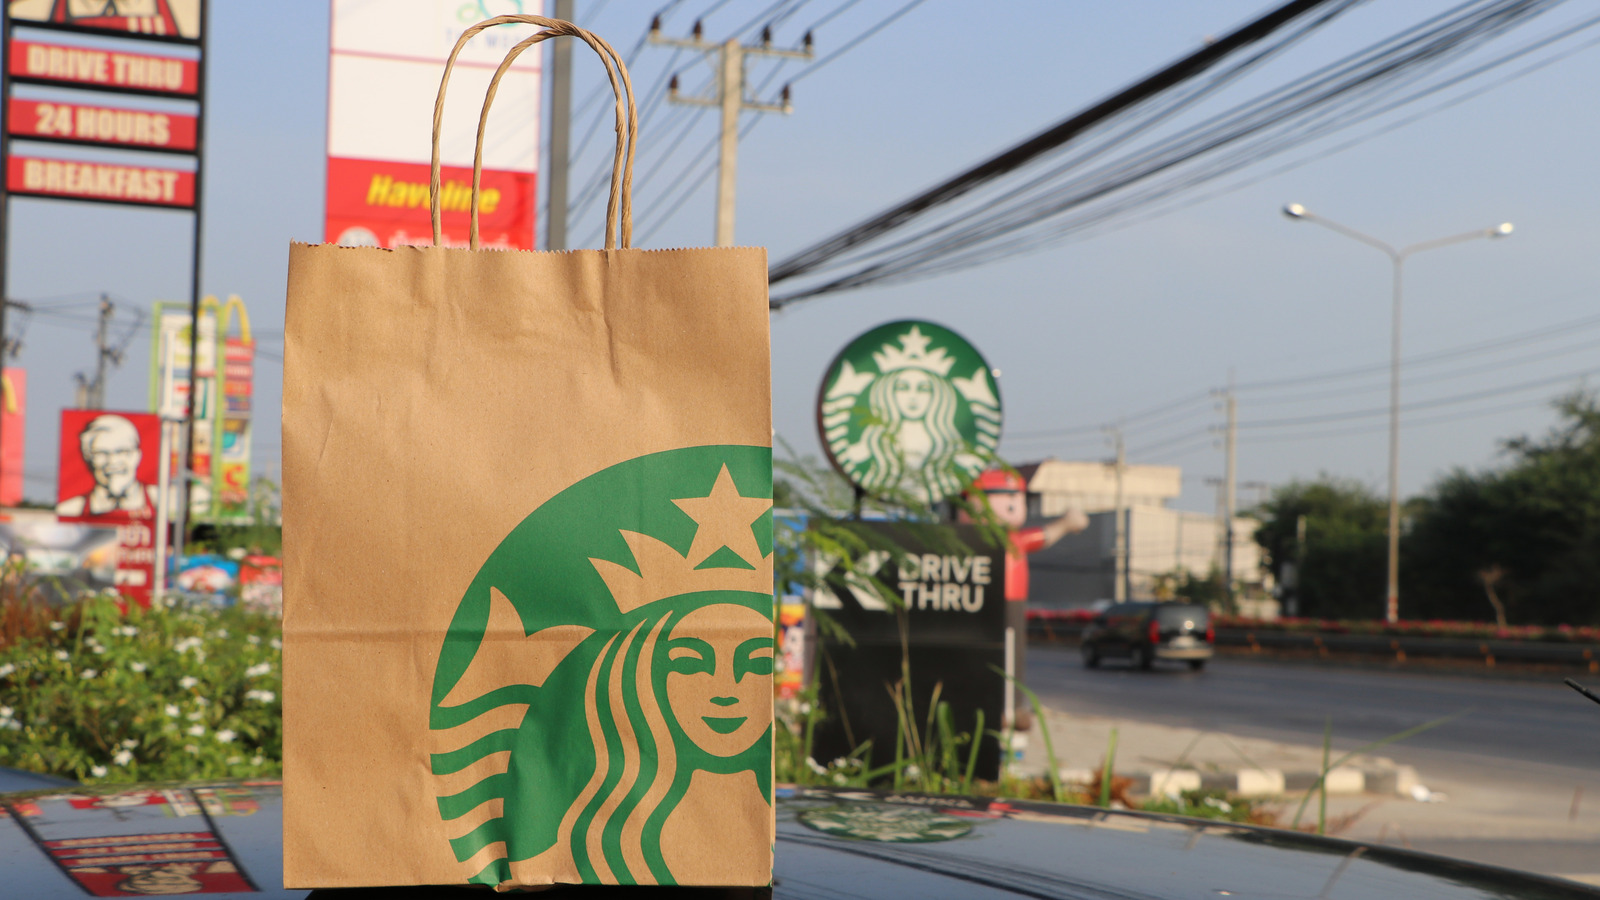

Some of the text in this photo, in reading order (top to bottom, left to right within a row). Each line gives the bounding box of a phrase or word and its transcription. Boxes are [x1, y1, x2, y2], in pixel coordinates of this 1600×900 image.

[27, 45, 182, 90] DRIVE THRU
[36, 103, 170, 145] 24 HOURS
[24, 160, 178, 200] BREAKFAST
[898, 553, 991, 584] DRIVE
[898, 582, 984, 612] THRU
